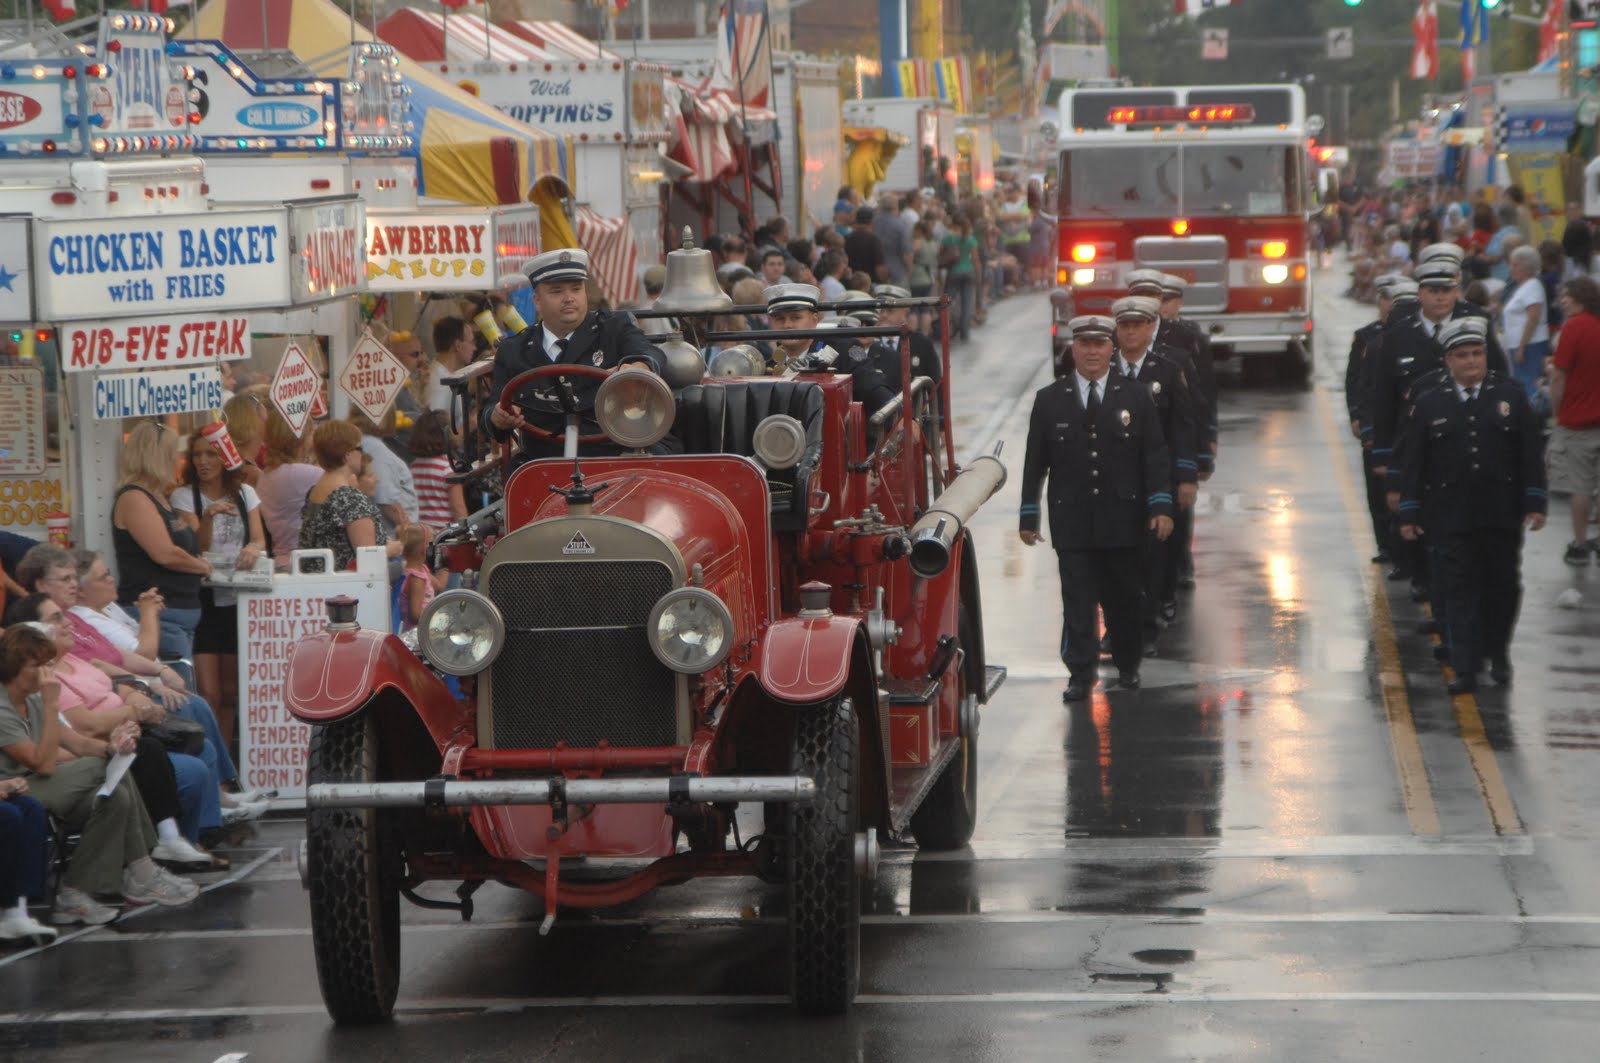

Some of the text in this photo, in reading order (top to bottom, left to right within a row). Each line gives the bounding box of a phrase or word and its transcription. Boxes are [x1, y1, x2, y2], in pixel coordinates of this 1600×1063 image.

[529, 79, 571, 96] With
[49, 225, 276, 275] CHICKEN BASKET
[368, 225, 485, 256] AWBERRY
[108, 273, 225, 303] with FRIES
[71, 318, 247, 369] RIB-EYE STEAK
[356, 352, 371, 370] 32
[282, 364, 305, 380] JUMBO
[350, 367, 397, 391] REFILLS
[138, 377, 187, 415] Cheese
[190, 372, 221, 410] Fries
[278, 377, 314, 401] CORNDOG
[364, 389, 386, 406] $2.00
[286, 400, 307, 416] $3.00
[0, 480, 62, 503] CORN
[0, 502, 62, 526] DOG
[570, 541, 587, 549] STUTZ
[248, 598, 301, 618] RIBEYE
[248, 620, 296, 638] PHILLY
[248, 684, 285, 702] HAM
[248, 705, 296, 723] HOT D
[249, 726, 311, 745] TENDER
[249, 769, 289, 788] CORN
